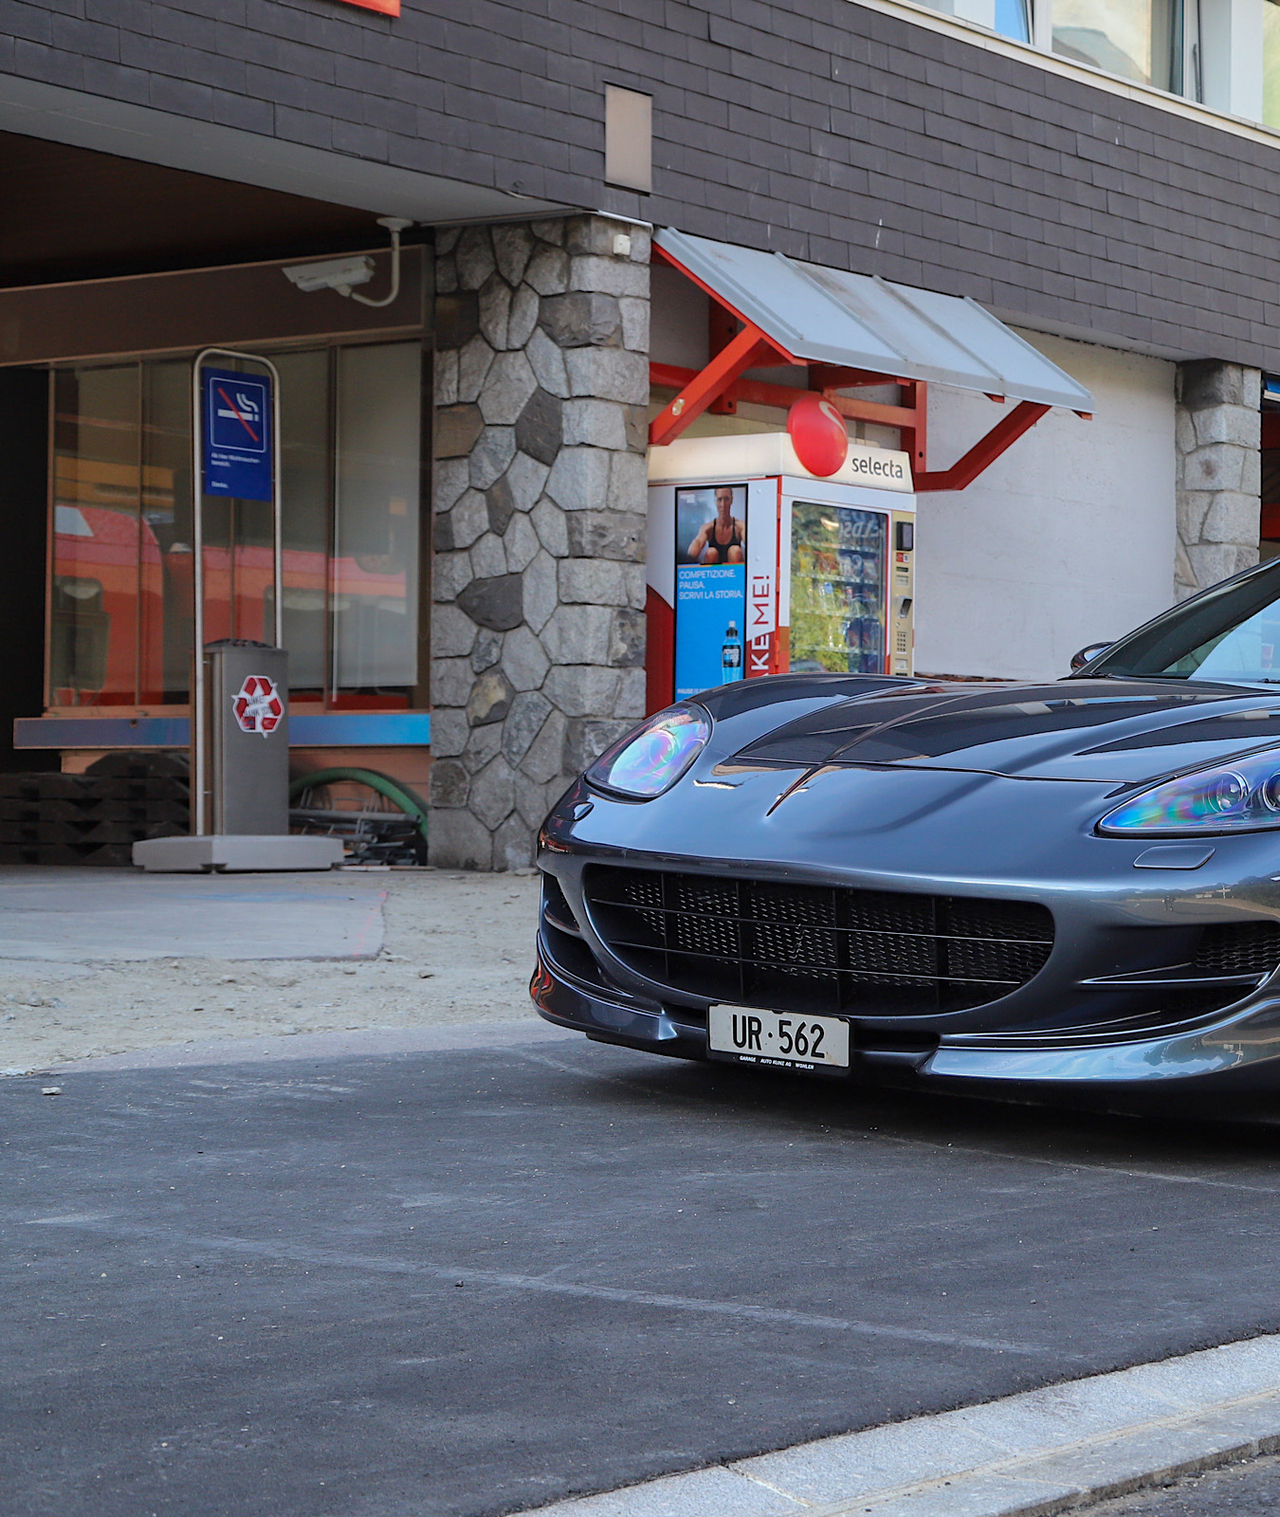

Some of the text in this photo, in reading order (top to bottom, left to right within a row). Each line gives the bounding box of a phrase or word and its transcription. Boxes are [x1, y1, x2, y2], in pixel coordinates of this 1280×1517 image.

[851, 456, 904, 479] selecta
[679, 590, 704, 600] SCRIVI
[704, 591, 715, 599] LA
[750, 575, 770, 676] KE ME!
[732, 1014, 762, 1051] UR
[778, 1019, 825, 1059] 562
